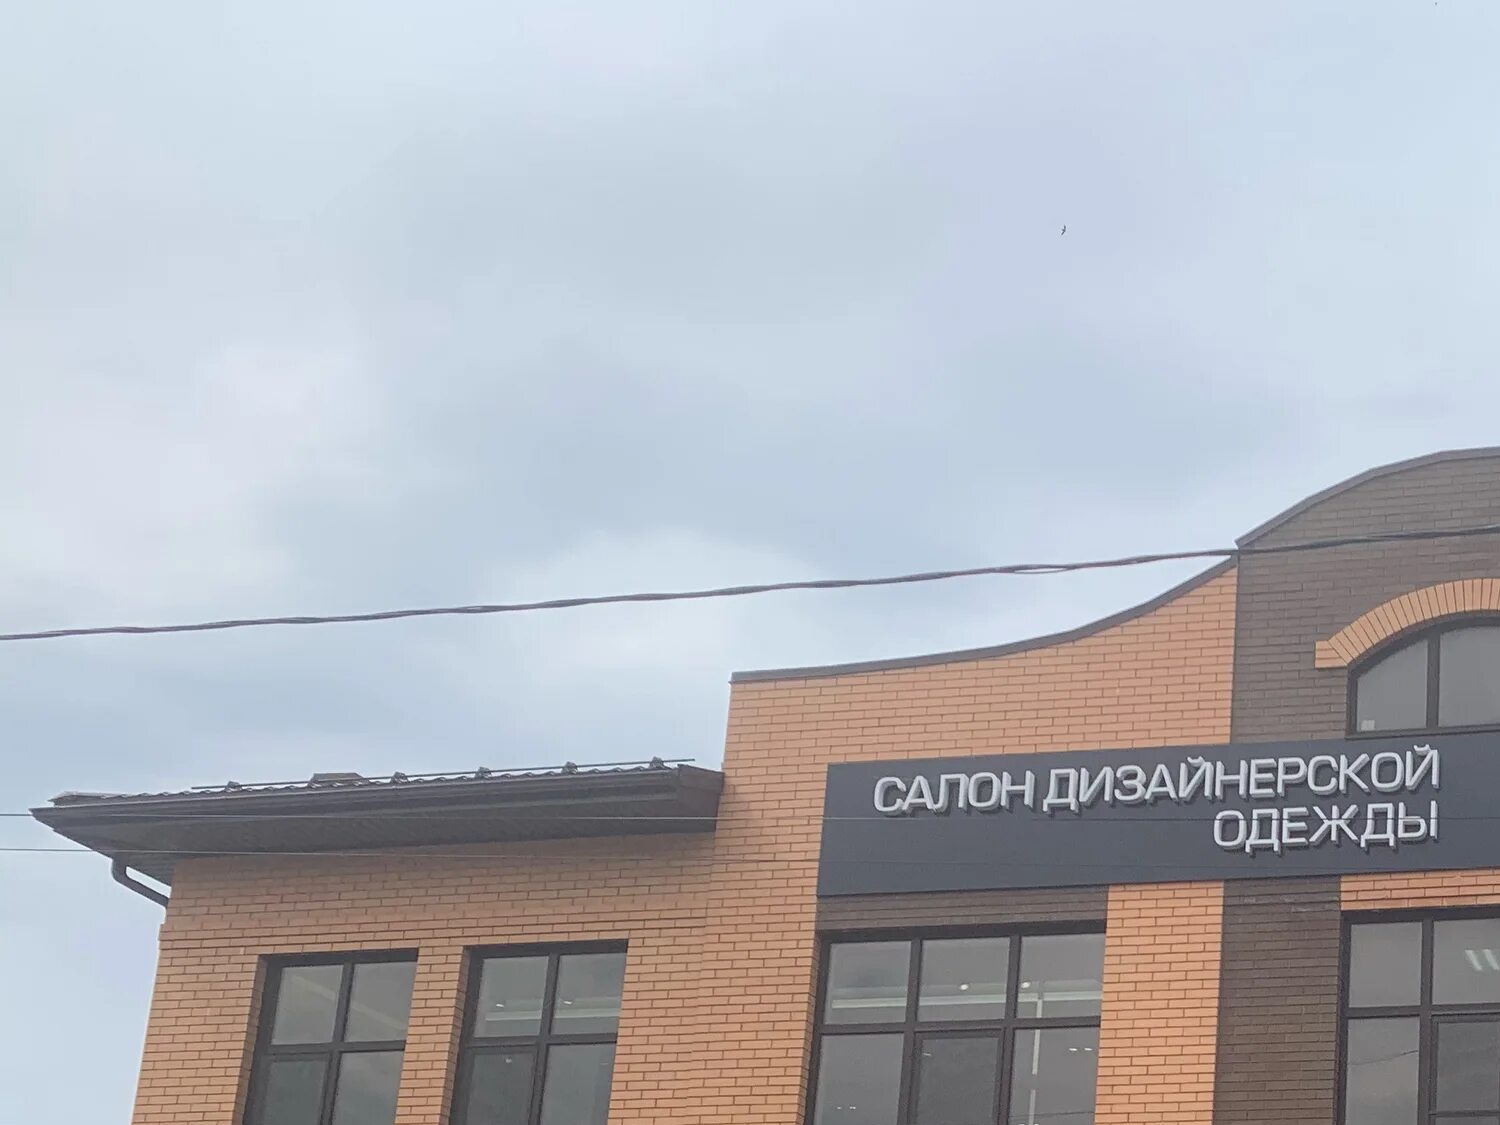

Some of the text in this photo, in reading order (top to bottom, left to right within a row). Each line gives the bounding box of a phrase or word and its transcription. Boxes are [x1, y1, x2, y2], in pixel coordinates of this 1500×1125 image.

[874, 744, 1441, 816] САЛОН ДИЗАЙНЕРСКОЙ
[1213, 801, 1440, 855] ОДЕЖДЫ
